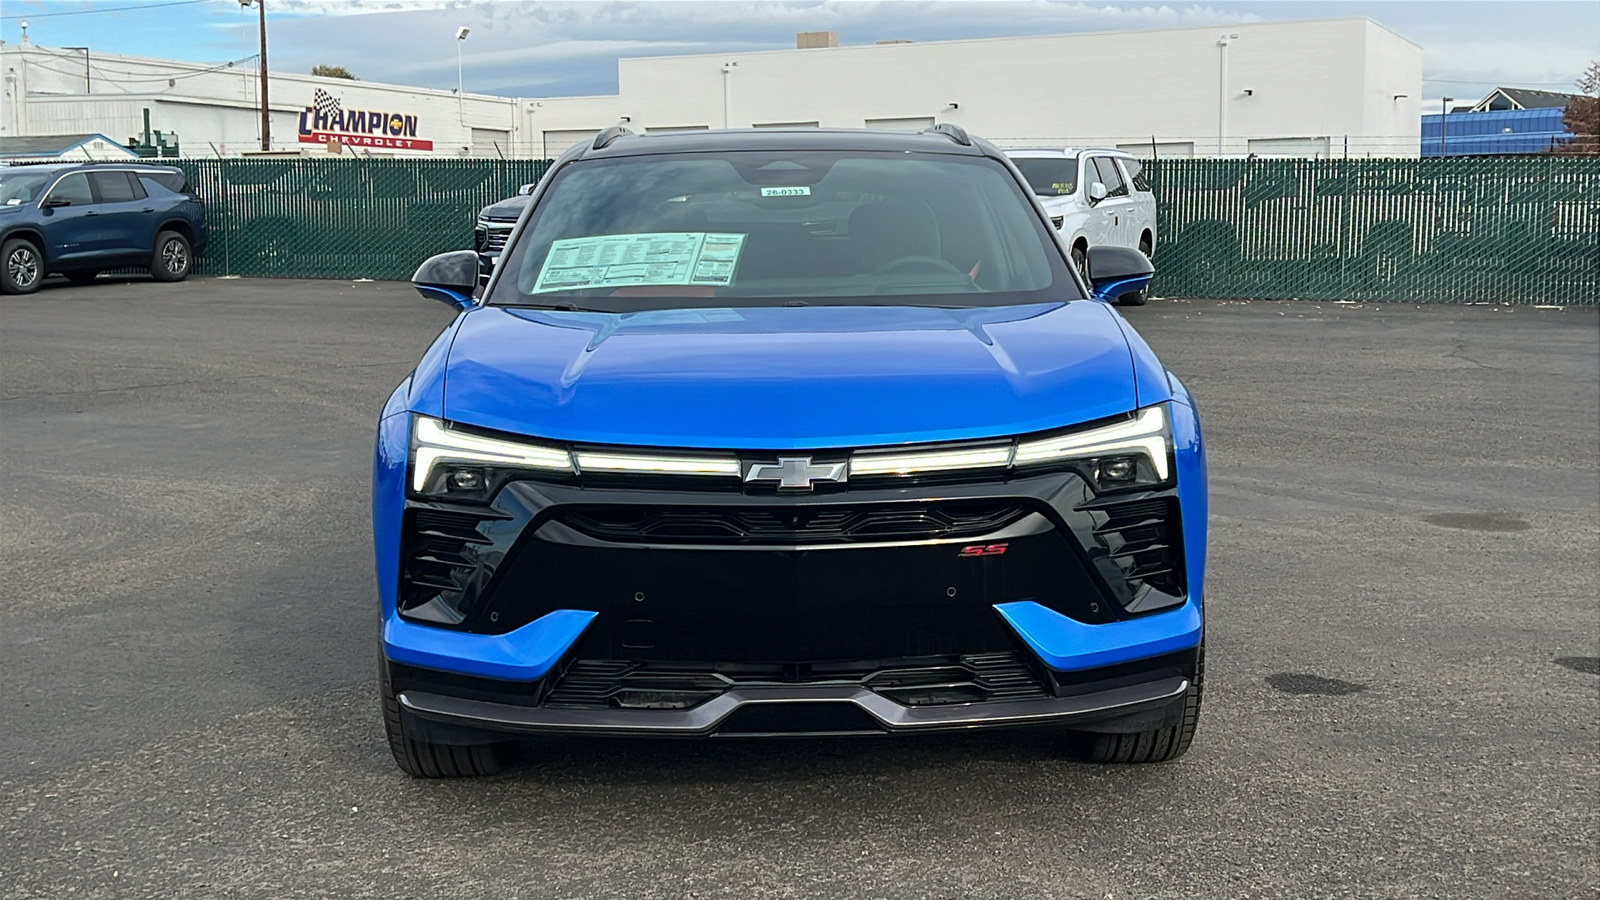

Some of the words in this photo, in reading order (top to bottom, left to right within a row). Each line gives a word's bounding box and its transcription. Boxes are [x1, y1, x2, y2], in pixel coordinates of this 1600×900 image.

[299, 106, 418, 137] CHAMPION
[318, 135, 413, 148] CHEVROLET
[766, 188, 804, 196] 26-0333
[957, 543, 1009, 557] SS
